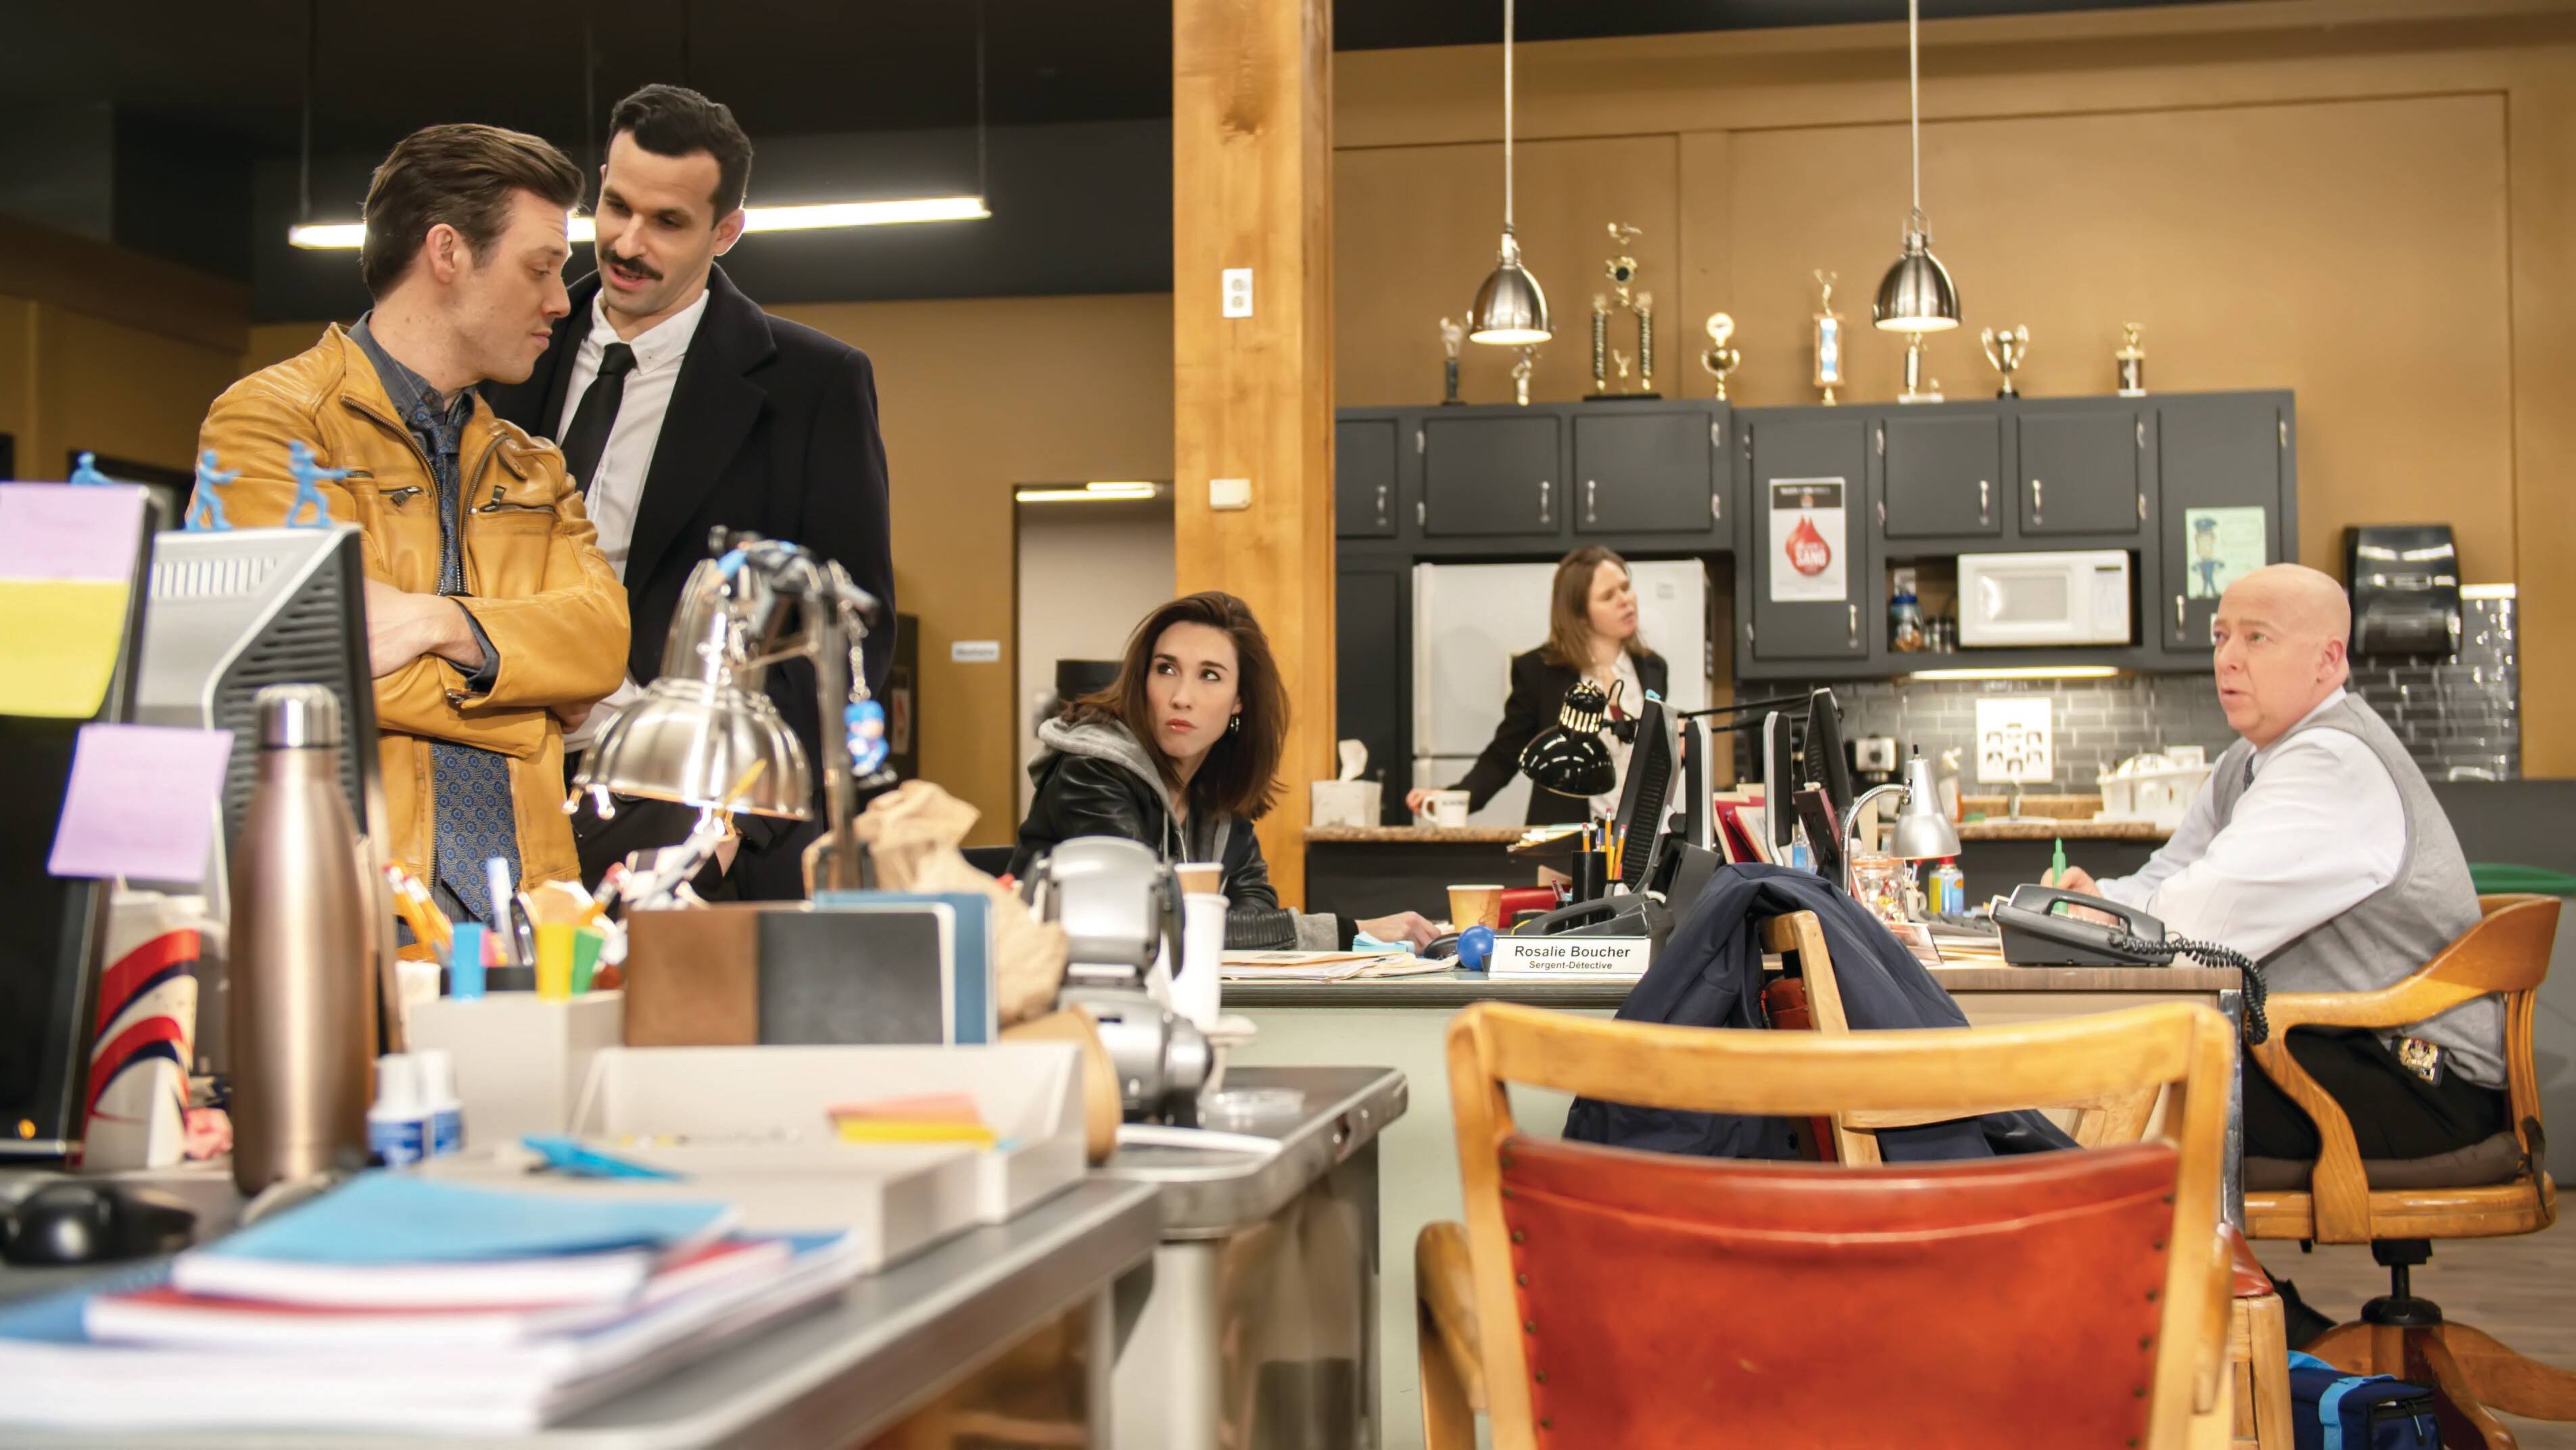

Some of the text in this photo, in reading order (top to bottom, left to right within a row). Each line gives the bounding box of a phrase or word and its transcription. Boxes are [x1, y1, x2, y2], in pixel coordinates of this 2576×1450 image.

[1514, 946, 1631, 957] Rosalie Boucher
[1529, 961, 1613, 970] Sergent-Détective
